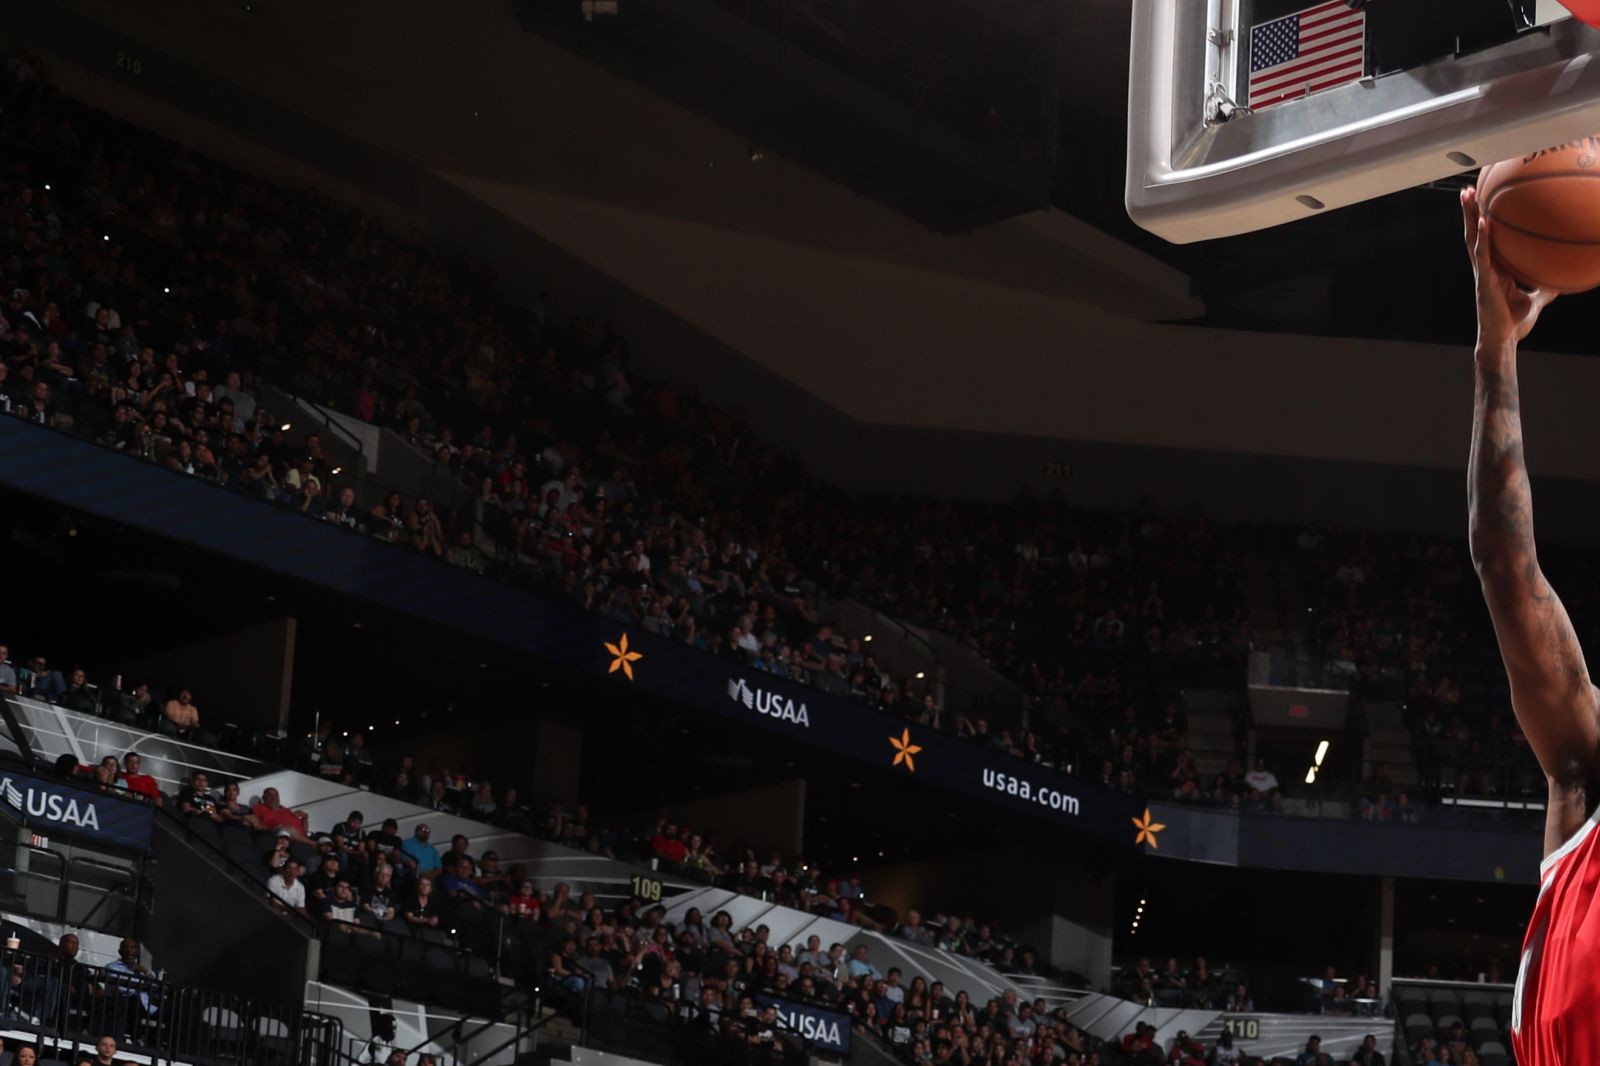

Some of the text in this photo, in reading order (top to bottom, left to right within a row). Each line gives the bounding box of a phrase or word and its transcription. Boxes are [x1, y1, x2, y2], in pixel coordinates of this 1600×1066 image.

[755, 688, 810, 728] USAA
[26, 788, 100, 831] USAA
[982, 767, 1080, 816] usaa.com
[631, 876, 662, 900] 109
[1225, 1020, 1259, 1039] 110
